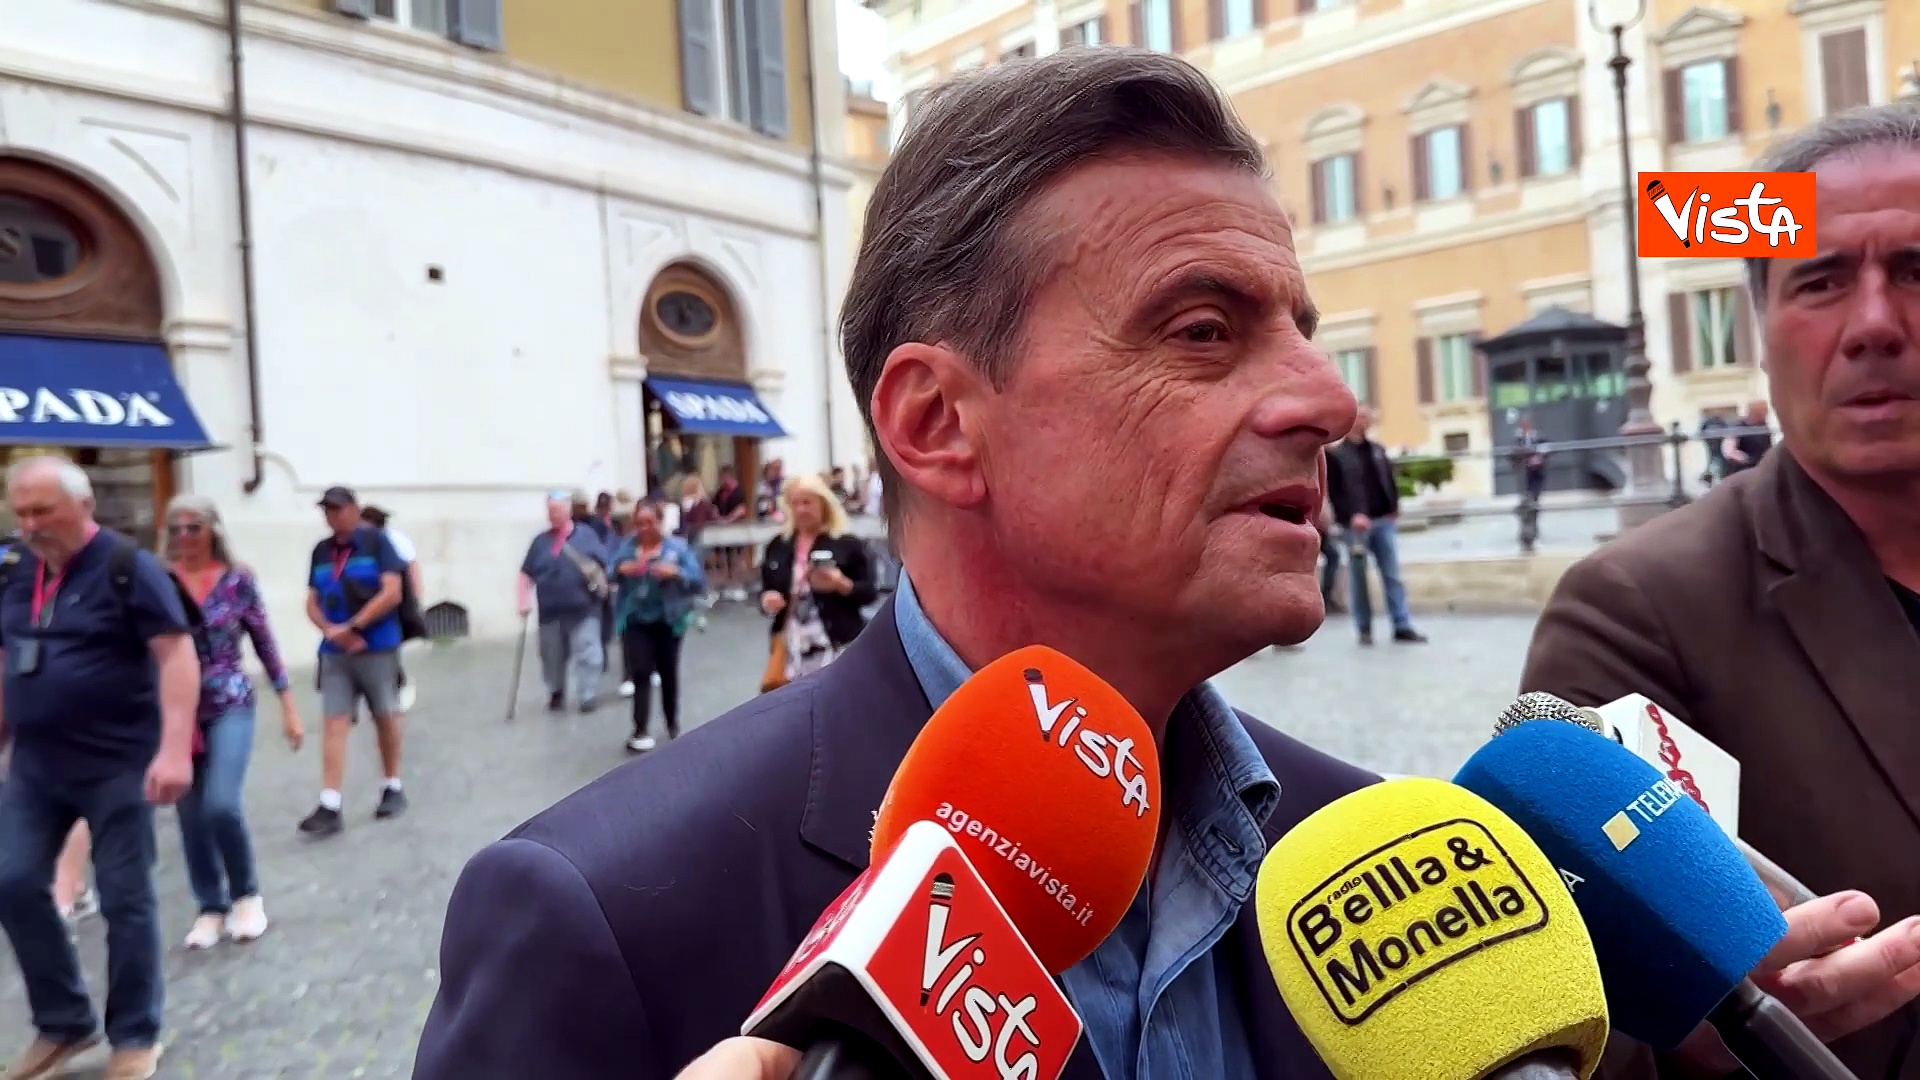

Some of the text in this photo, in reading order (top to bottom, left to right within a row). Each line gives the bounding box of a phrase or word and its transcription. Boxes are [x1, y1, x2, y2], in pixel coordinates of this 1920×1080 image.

[935, 801, 1095, 927] agenziavista.it
[1297, 836, 1494, 957] Bellla &
[1327, 876, 1362, 904] radio
[1325, 880, 1526, 1007] Monella
